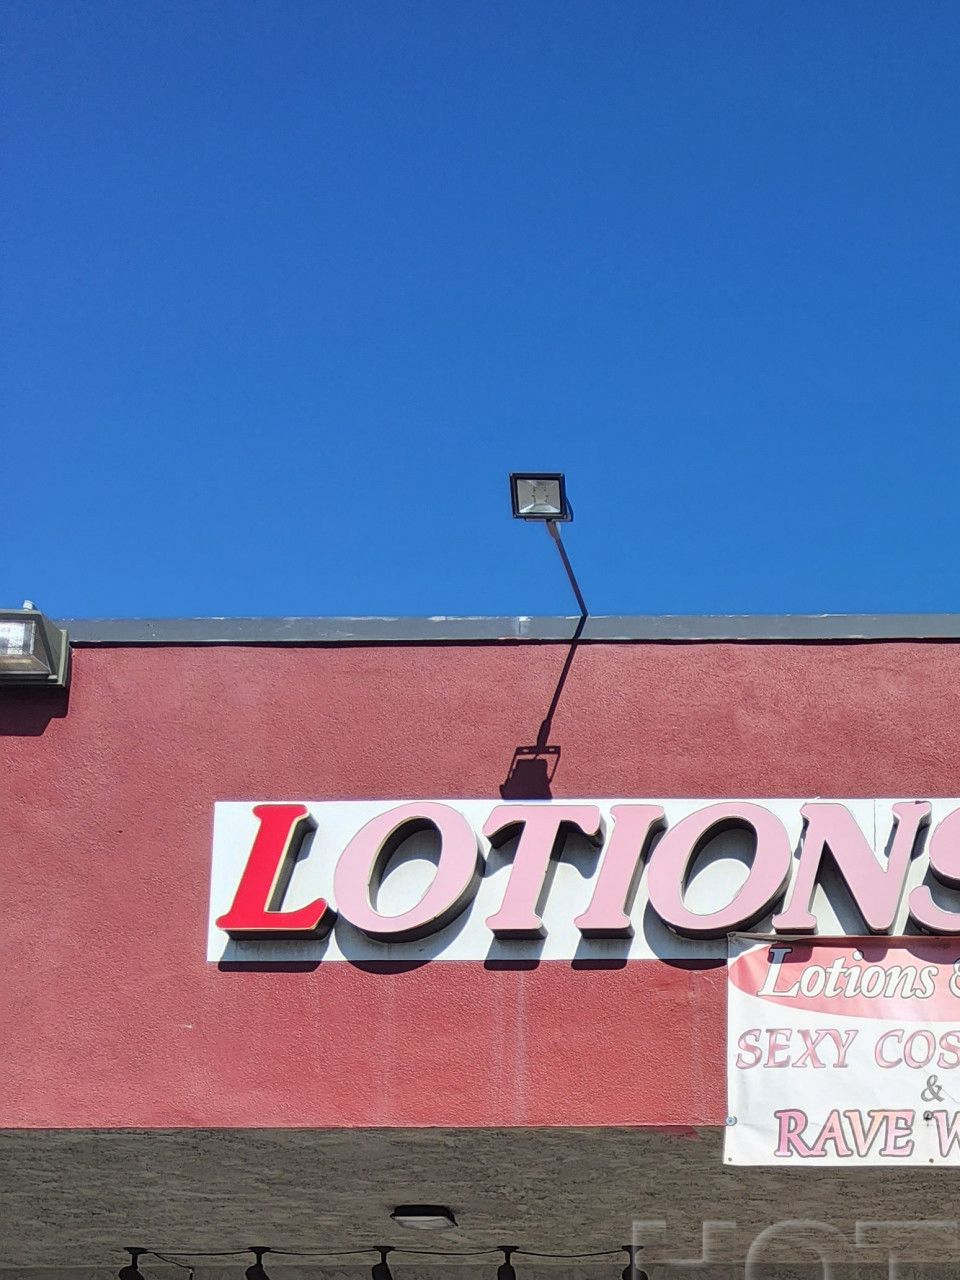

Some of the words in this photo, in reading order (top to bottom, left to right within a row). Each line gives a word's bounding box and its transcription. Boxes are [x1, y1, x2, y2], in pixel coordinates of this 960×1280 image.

[757, 947, 939, 999] Lotions
[736, 1028, 858, 1069] SEXY
[920, 1075, 945, 1102] &
[774, 1109, 915, 1158] RAVE
